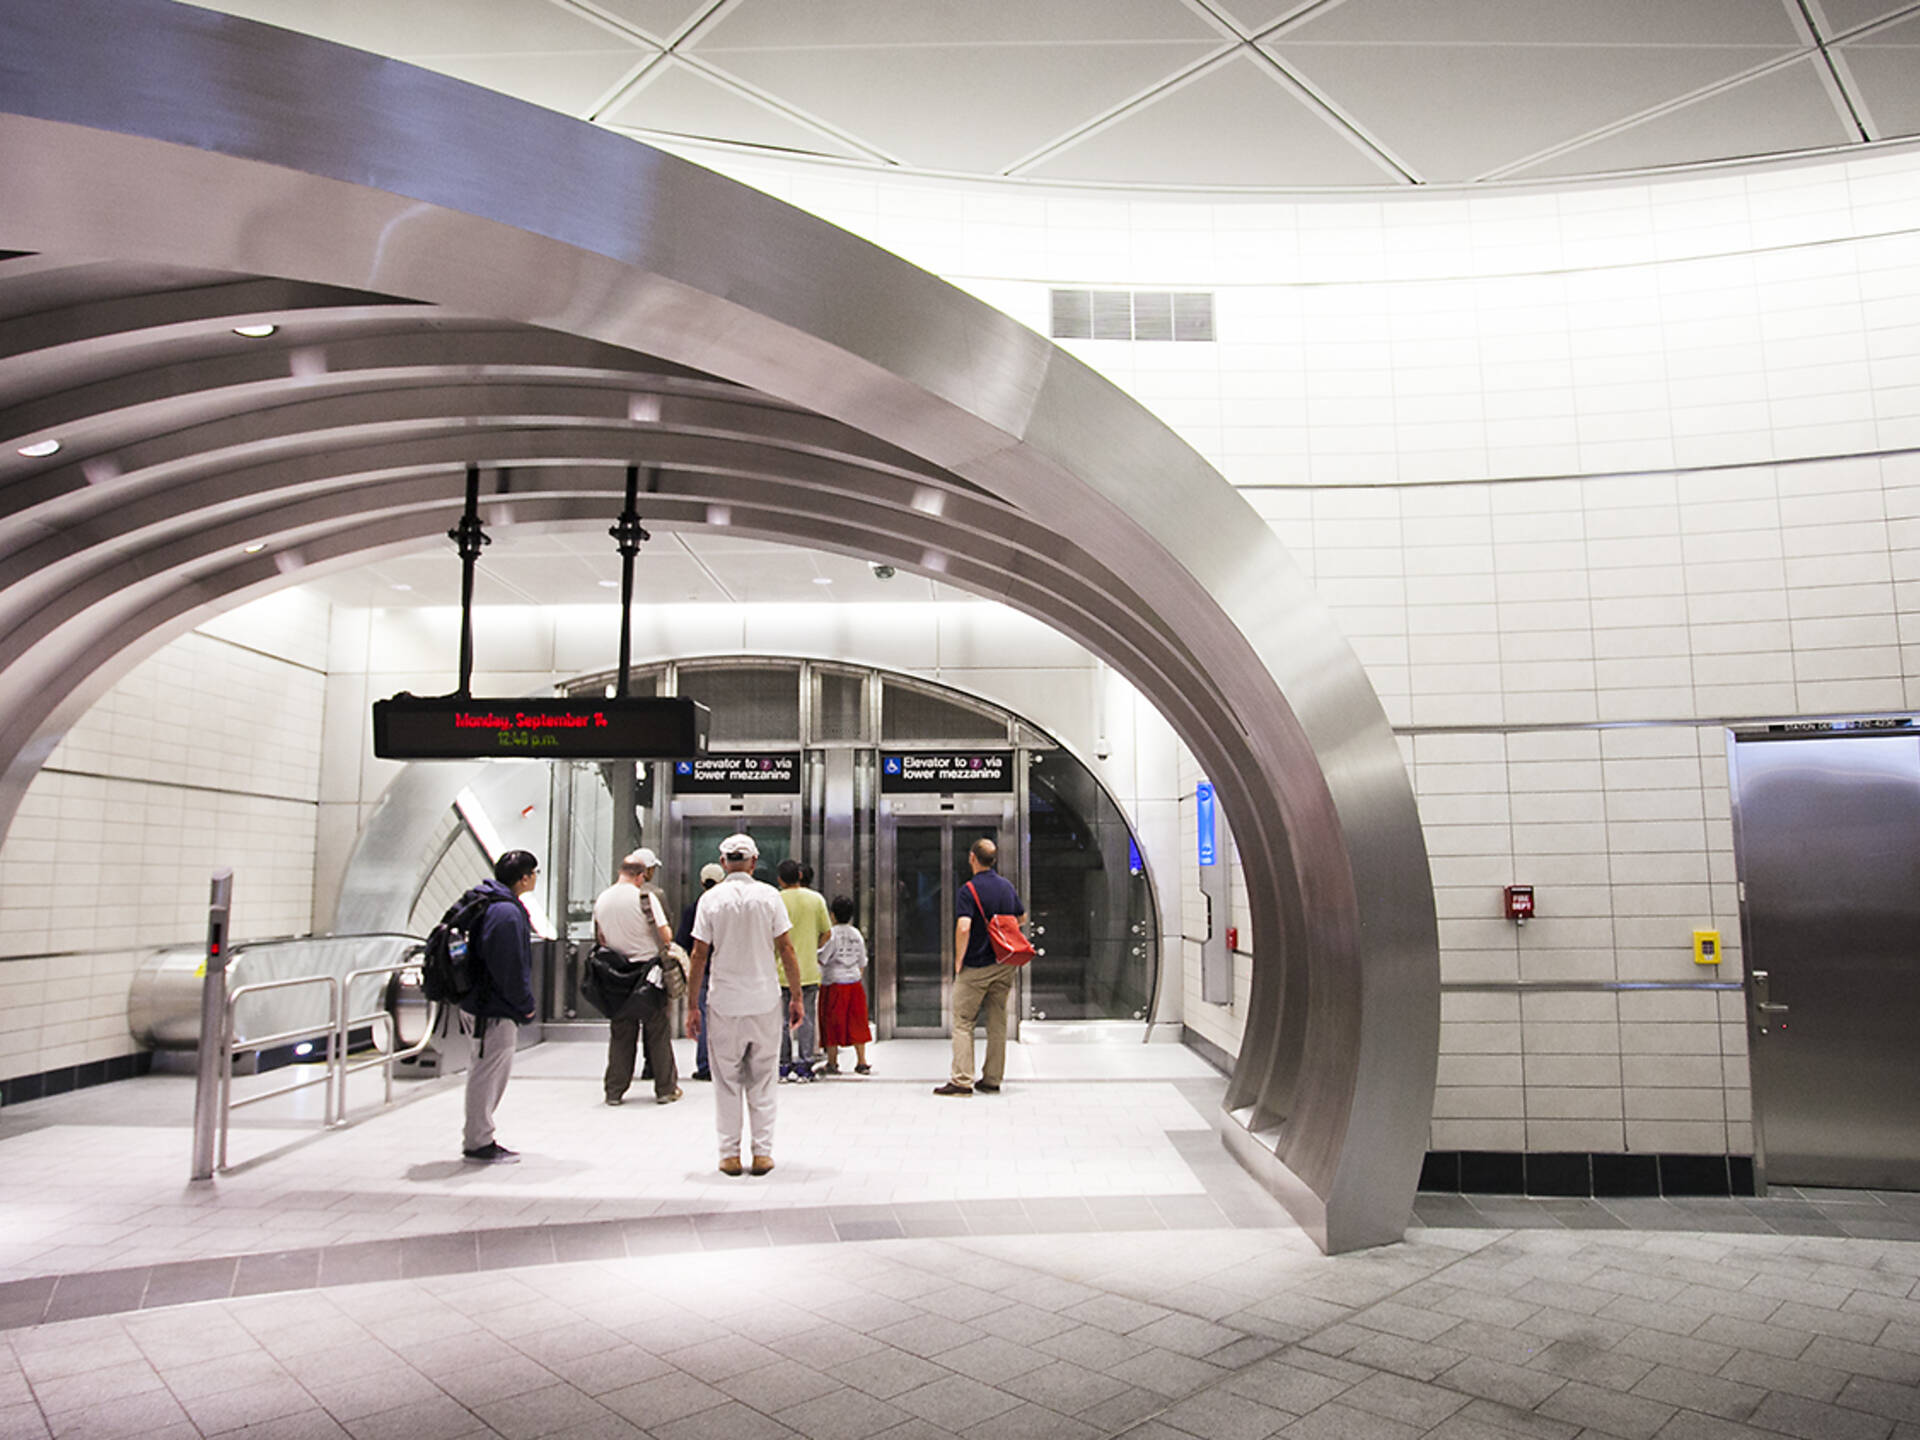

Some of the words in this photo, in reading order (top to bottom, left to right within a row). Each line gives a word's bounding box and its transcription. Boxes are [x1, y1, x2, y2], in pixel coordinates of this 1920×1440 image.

[455, 712, 513, 730] Monday,
[516, 712, 589, 730] September
[695, 758, 740, 769] Elevator
[745, 758, 758, 769] to
[775, 758, 792, 769] via
[903, 756, 950, 768] Elevator
[954, 757, 967, 768] to
[985, 756, 1003, 768] via
[694, 769, 726, 780] lower
[729, 769, 791, 780] mezzanine
[903, 768, 935, 779] lower
[939, 768, 1001, 779] mezzanine
